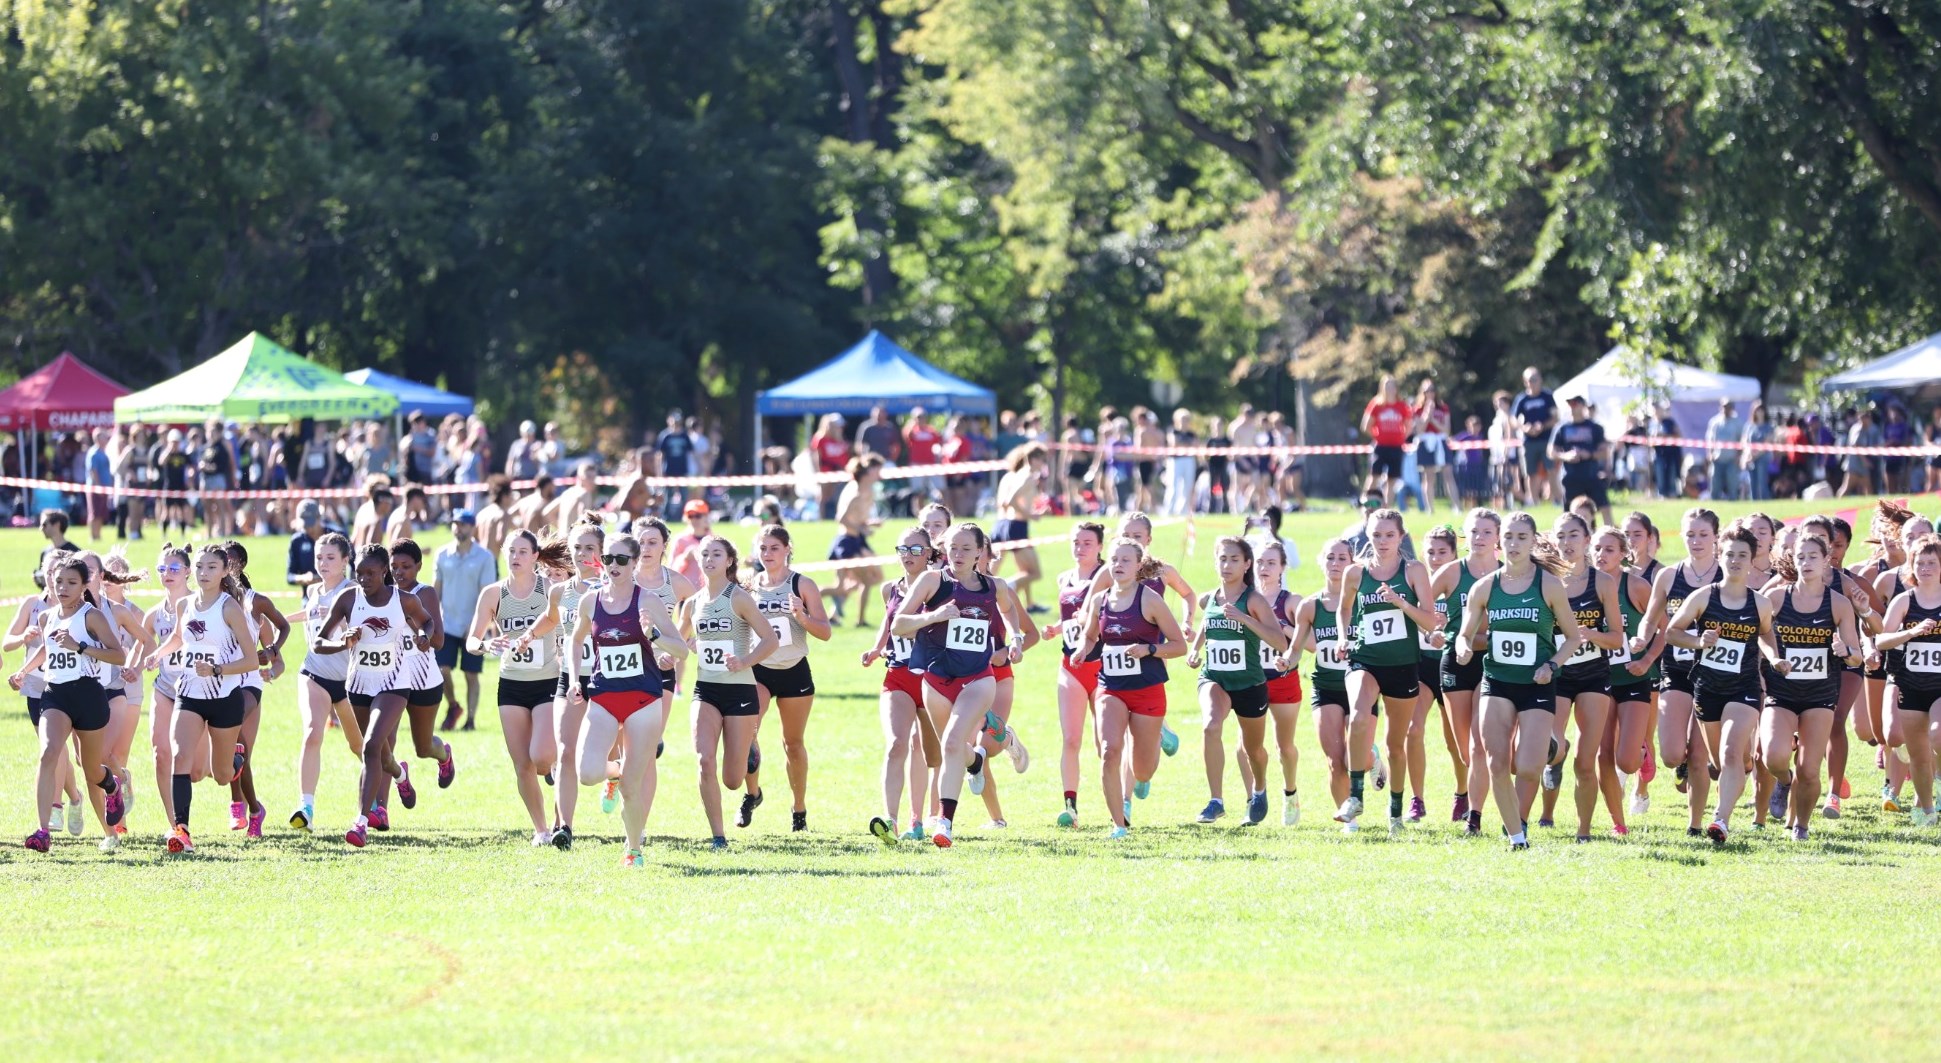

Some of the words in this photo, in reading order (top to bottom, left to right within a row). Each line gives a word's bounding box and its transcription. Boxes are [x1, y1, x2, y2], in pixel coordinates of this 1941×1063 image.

[758, 600, 790, 613] CCS
[1573, 610, 1600, 618] RADO
[502, 615, 537, 632] UCC
[1488, 608, 1539, 623] PARKSIDE
[697, 618, 732, 634] CCS
[1066, 626, 1084, 643] 12
[1372, 617, 1394, 637] 97
[1719, 627, 1750, 641] LLEGE
[1777, 625, 1832, 636] COLORADO
[953, 625, 985, 645] 128
[1781, 635, 1826, 644] COLLEGE
[704, 648, 725, 664] 32
[1211, 647, 1241, 665] 106
[1501, 640, 1526, 658] 99
[1705, 645, 1739, 666] 229
[49, 652, 77, 670] 295
[359, 650, 391, 667] 293
[604, 652, 639, 672] 124
[1106, 653, 1136, 669] 115
[1790, 656, 1824, 673] 224
[1910, 649, 1941, 667] 219
